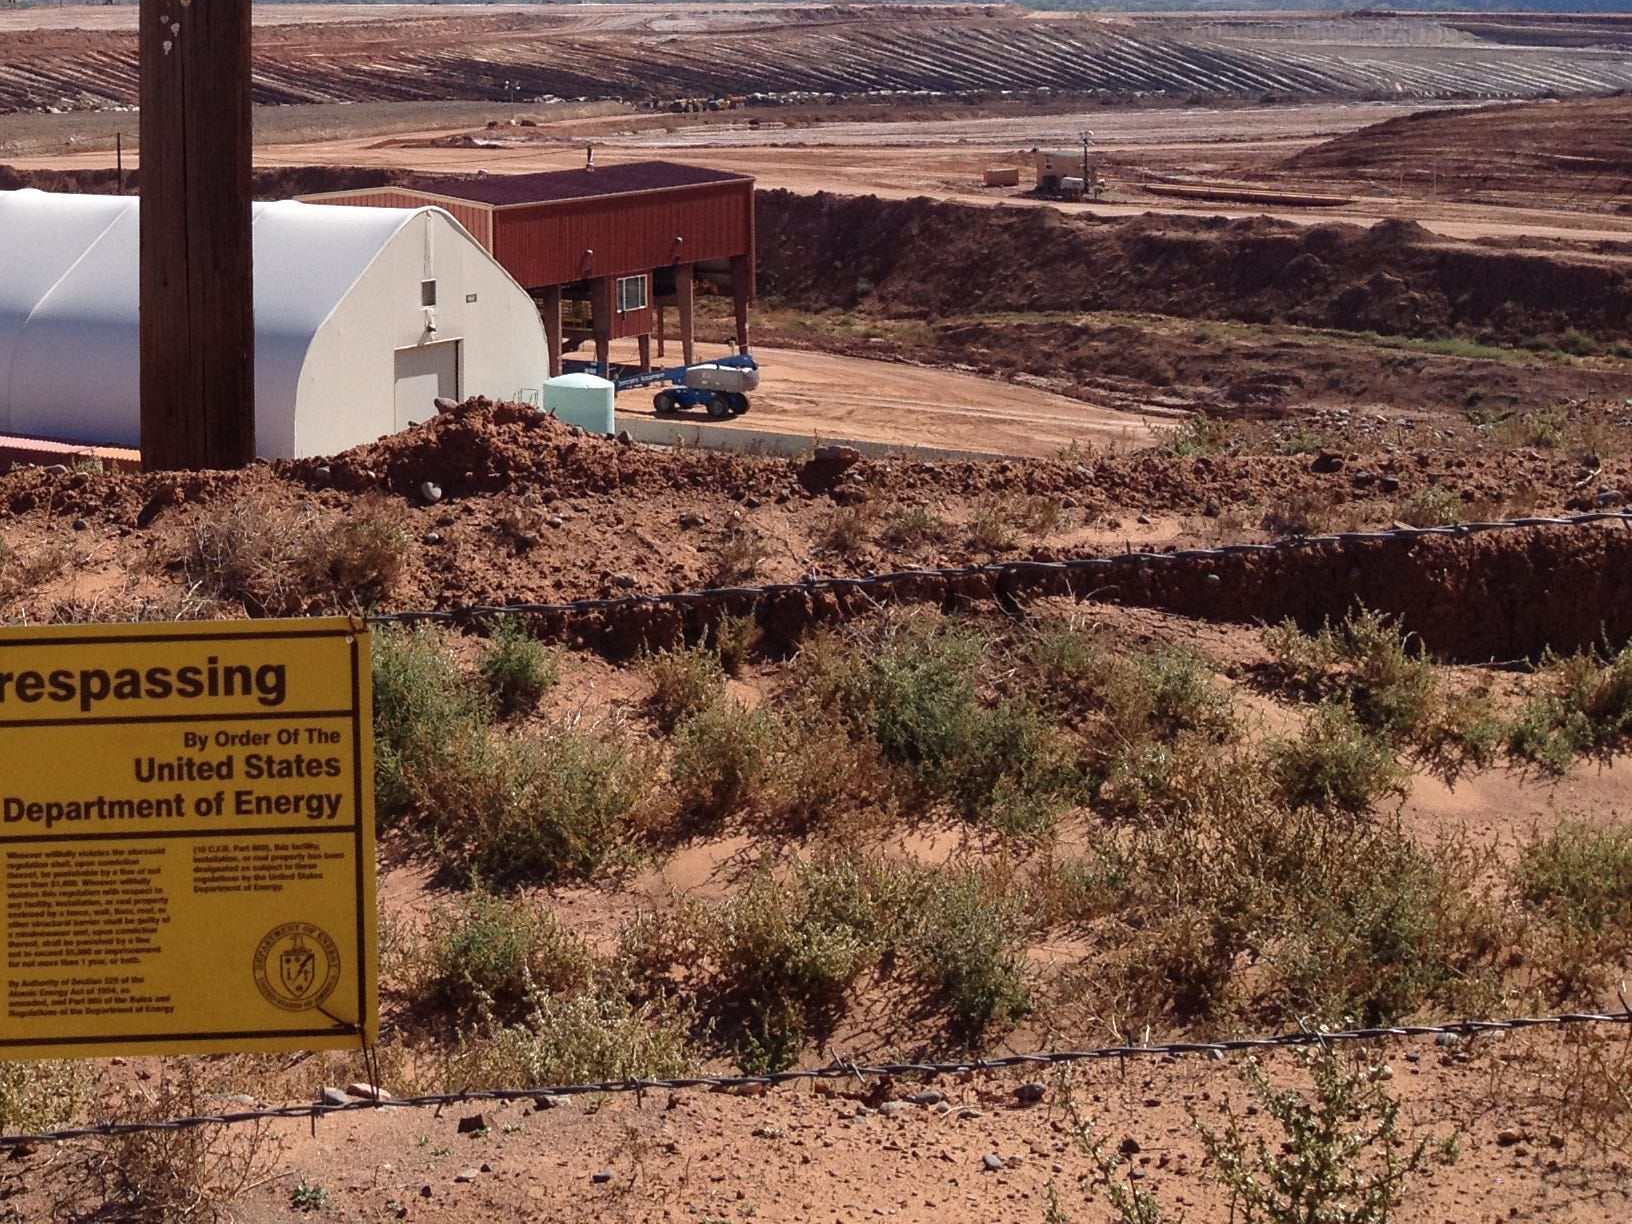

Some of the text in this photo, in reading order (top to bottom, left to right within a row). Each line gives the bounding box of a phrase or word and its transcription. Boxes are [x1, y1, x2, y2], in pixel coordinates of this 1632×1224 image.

[184, 728, 341, 750] By Order Of The
[134, 754, 341, 782] United States
[3, 790, 342, 828] Department of Energy
